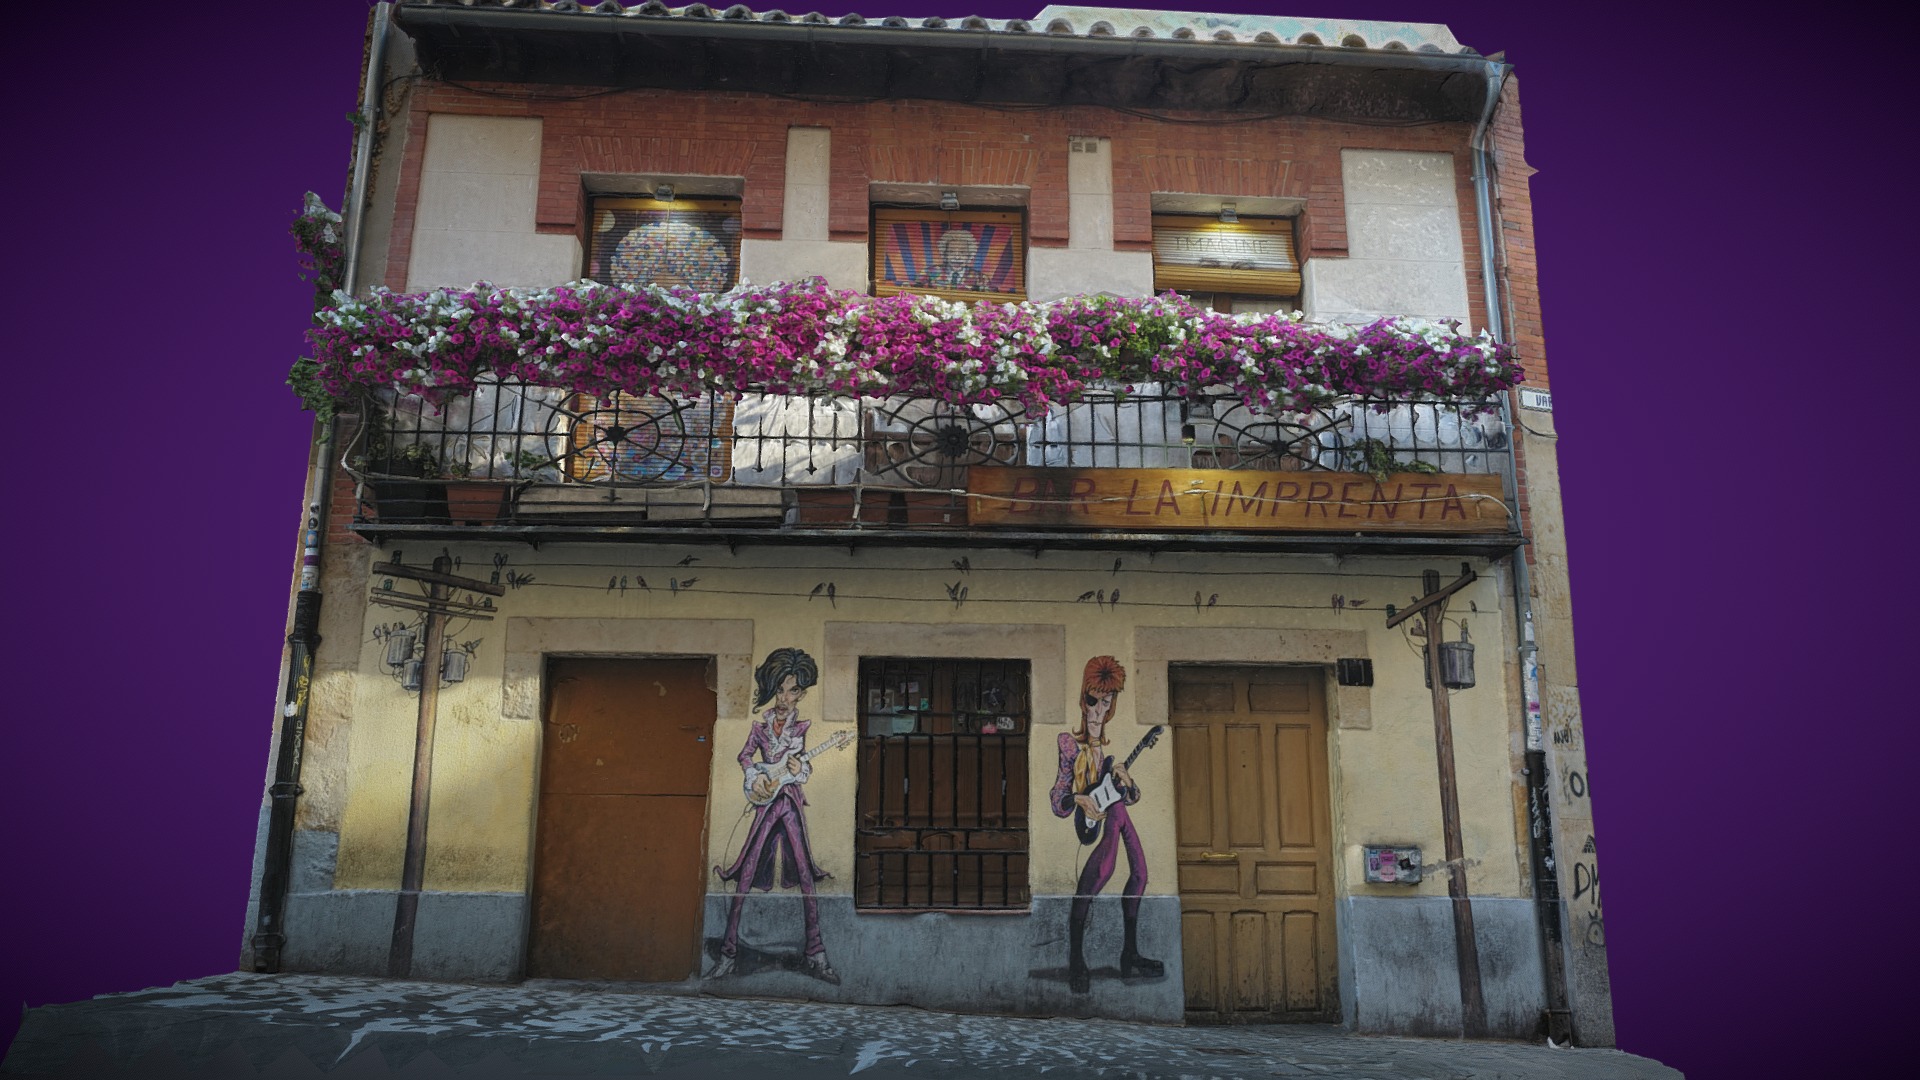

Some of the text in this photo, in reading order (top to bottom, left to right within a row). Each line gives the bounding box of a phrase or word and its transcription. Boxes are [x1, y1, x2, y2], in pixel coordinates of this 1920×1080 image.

[1175, 236, 1270, 254] IMAGINE
[1008, 476, 1467, 520] BAR LA IMPRENTA
